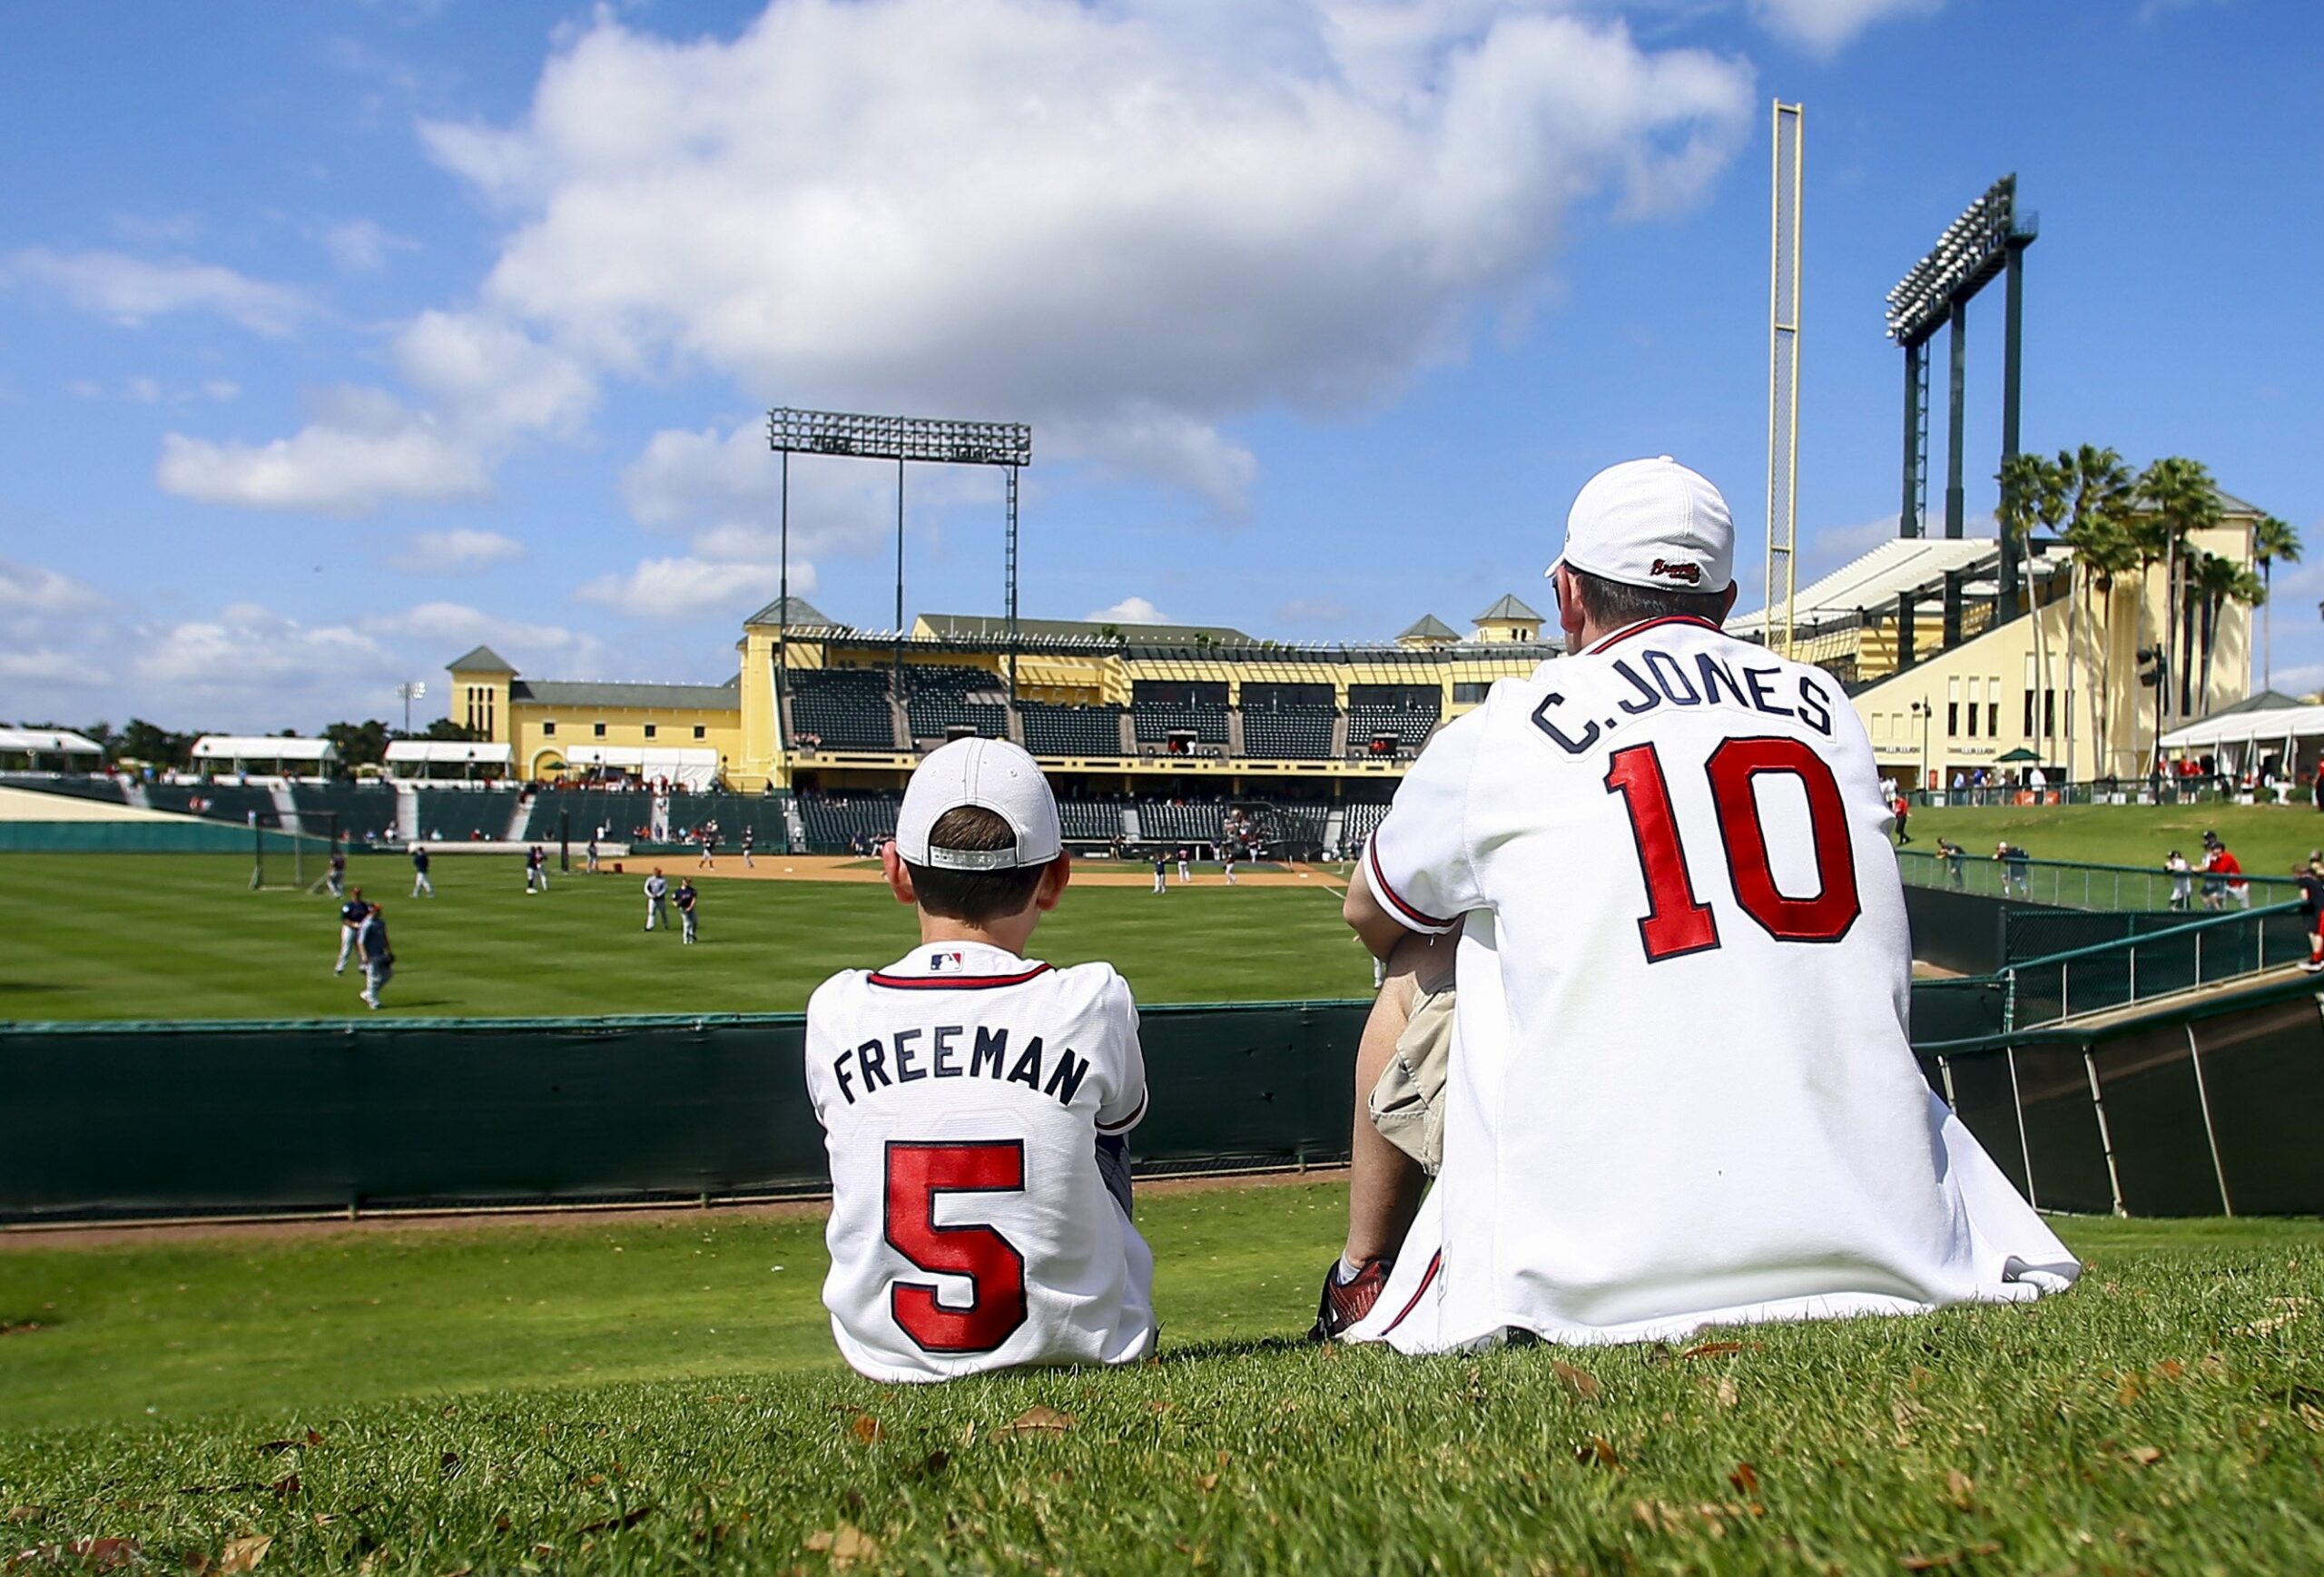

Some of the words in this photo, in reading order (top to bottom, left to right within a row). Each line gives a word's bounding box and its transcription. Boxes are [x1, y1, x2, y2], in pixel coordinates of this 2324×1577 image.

[1531, 649, 1832, 754] C.JONES
[1604, 735, 1862, 964] 10
[833, 1026, 1089, 1105] FREEMAN
[884, 1138, 1028, 1353] 5
